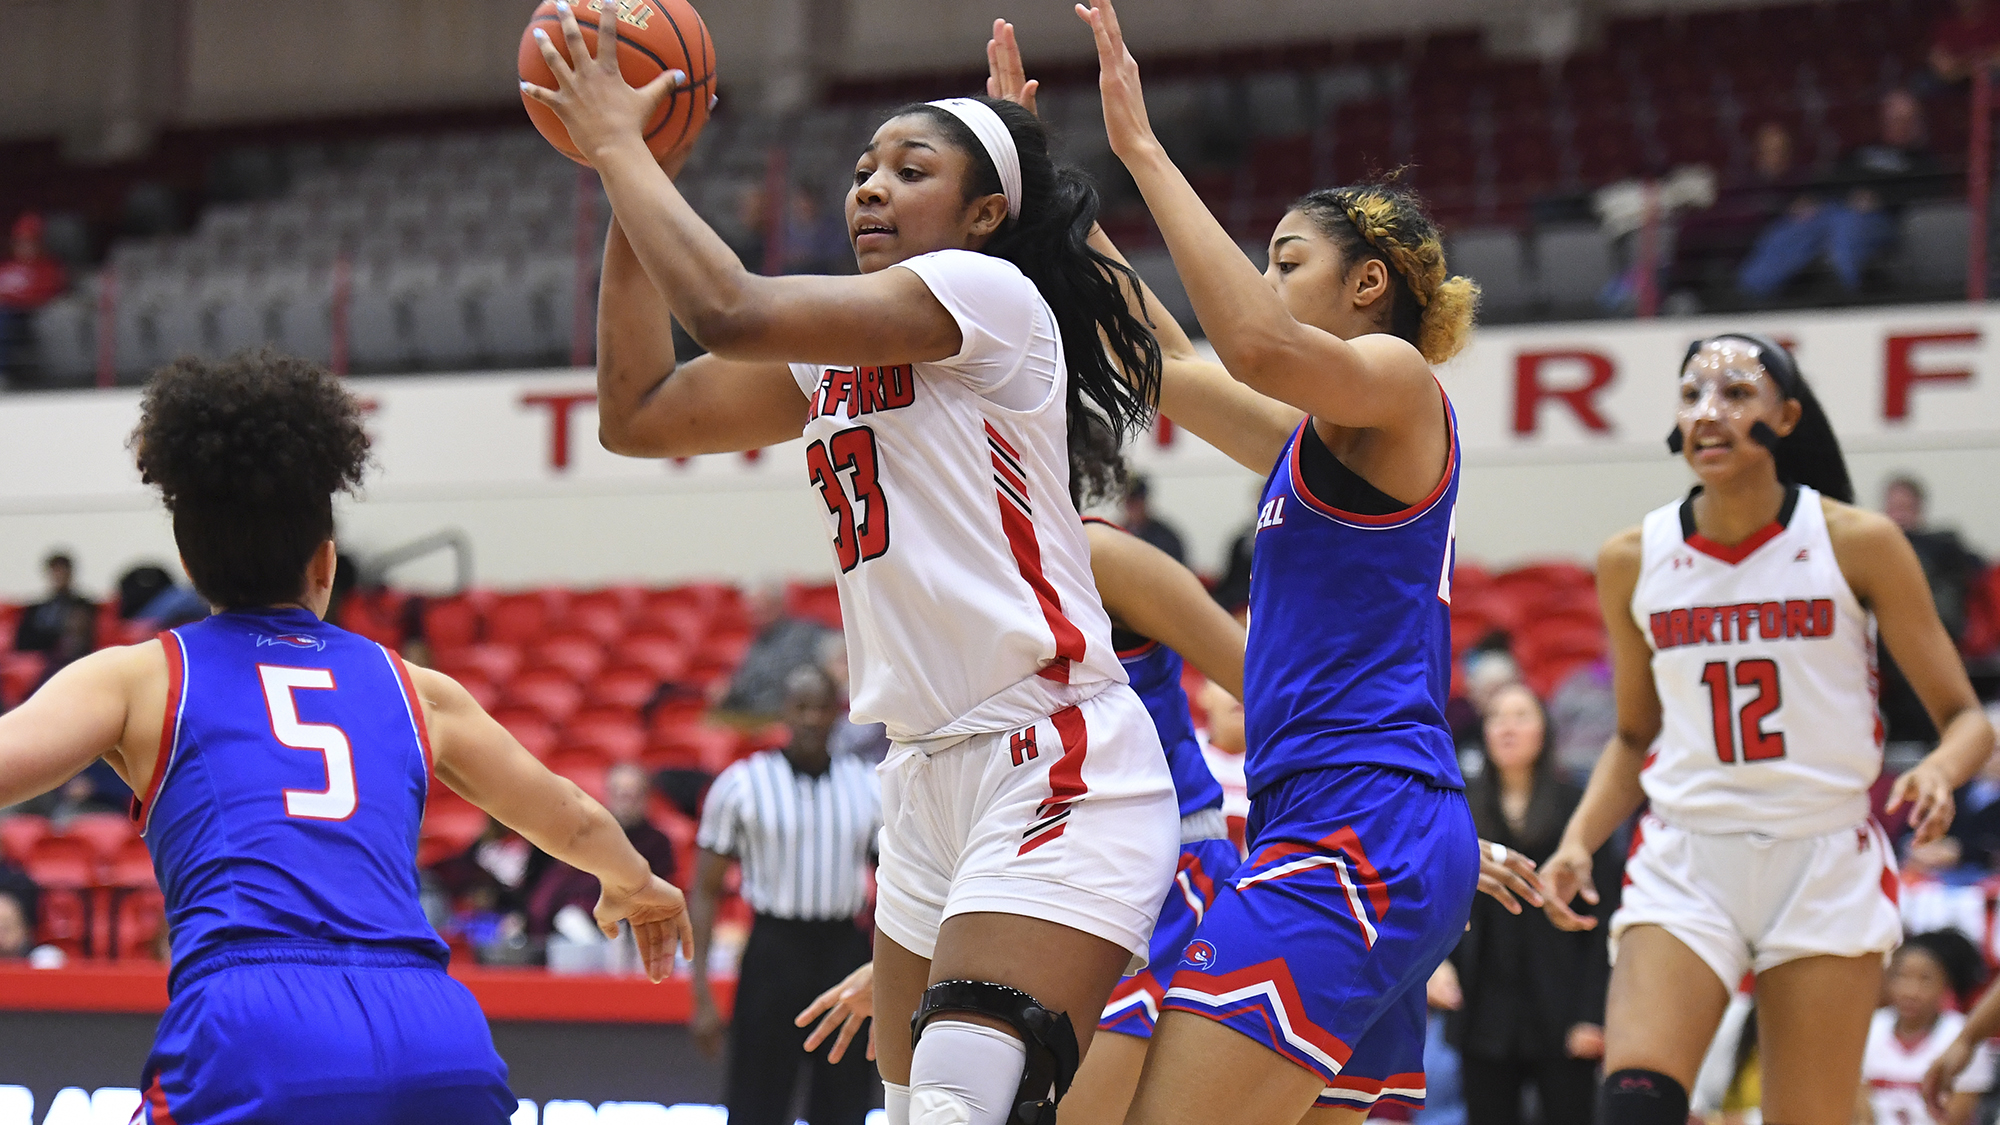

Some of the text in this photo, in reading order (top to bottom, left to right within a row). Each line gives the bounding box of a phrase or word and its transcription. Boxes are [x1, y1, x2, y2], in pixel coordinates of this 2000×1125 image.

[806, 425, 890, 575] 33
[1649, 598, 1836, 650] HARTFORD
[255, 662, 359, 822] 5
[1700, 658, 1786, 764] 12
